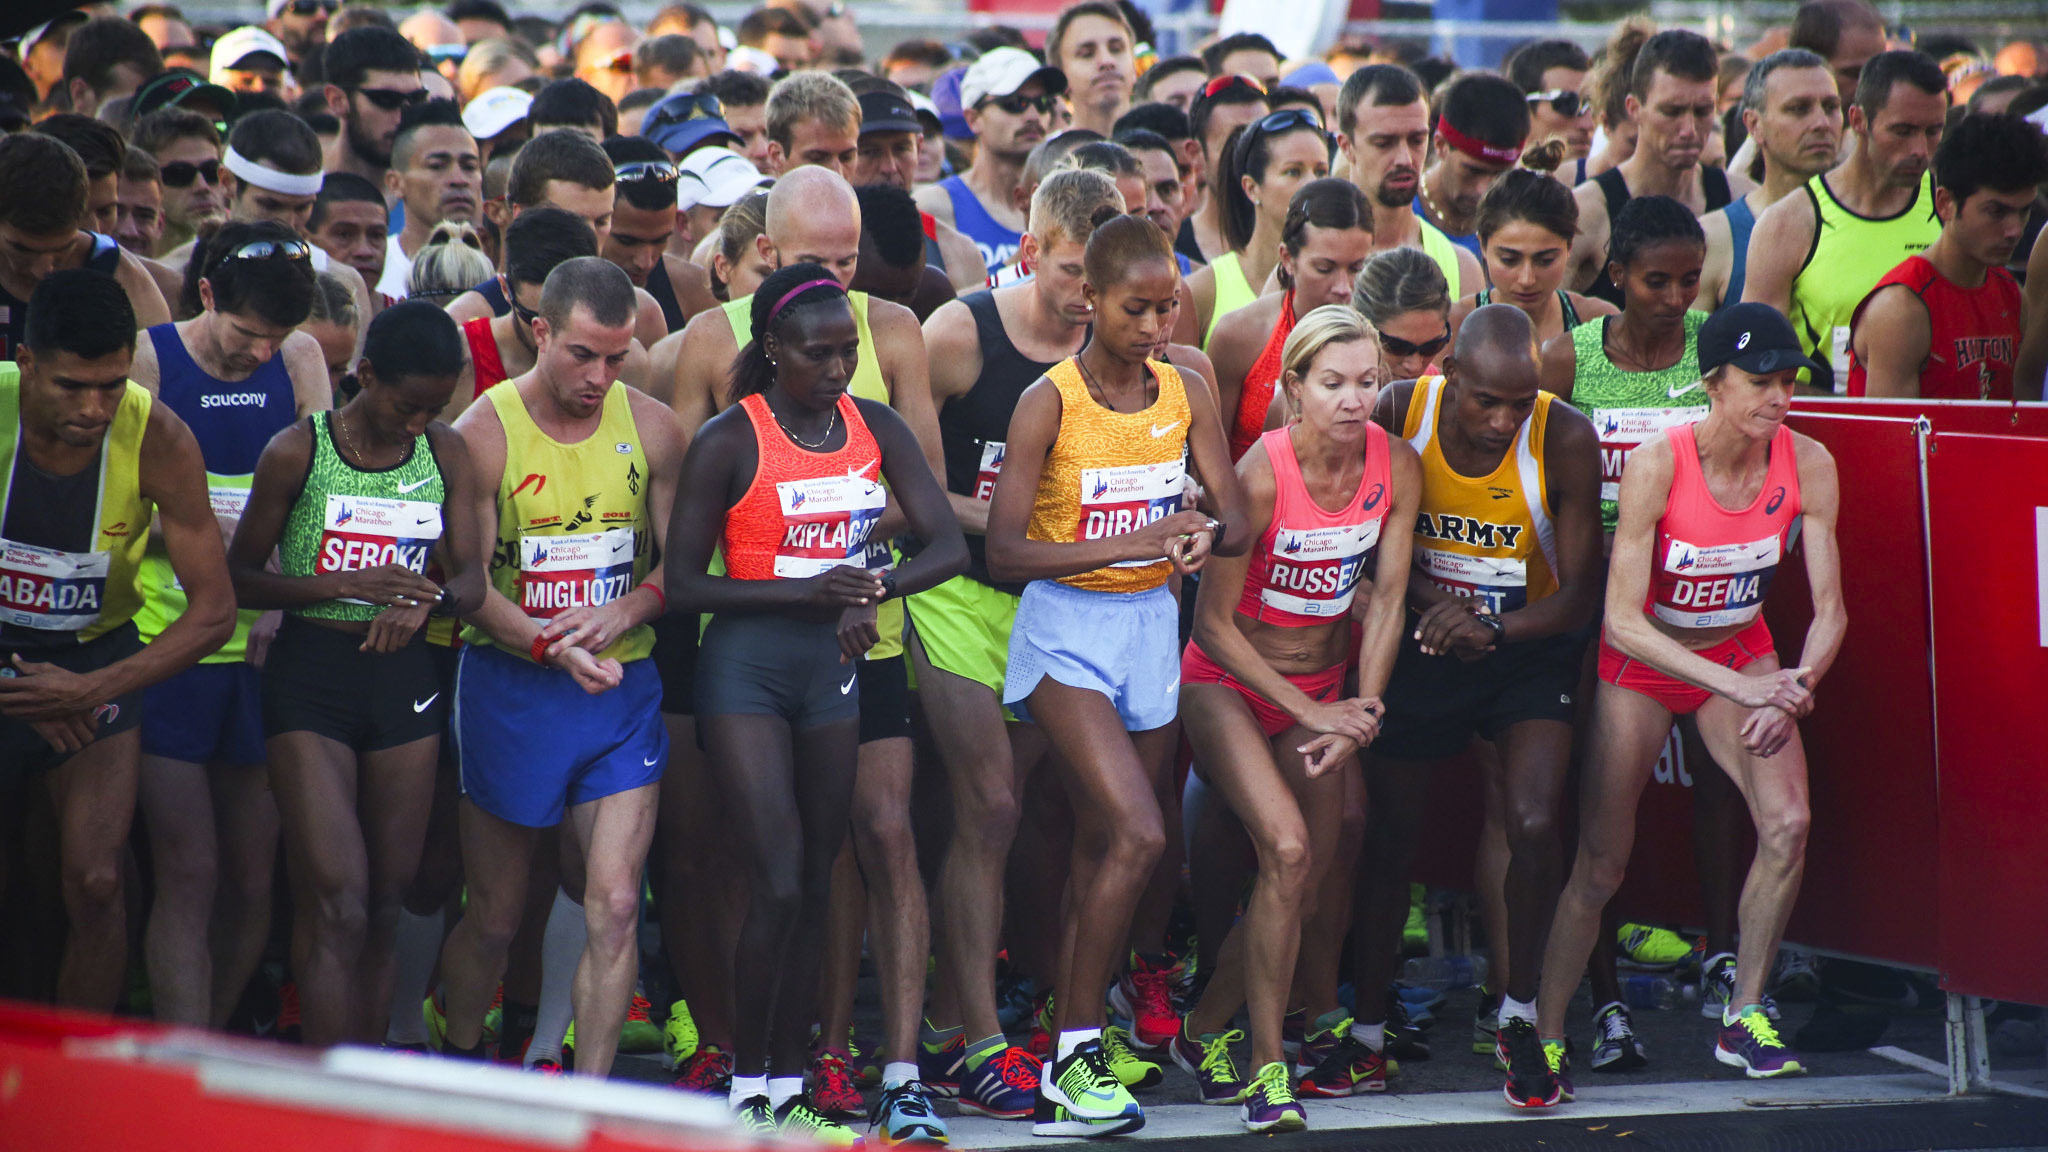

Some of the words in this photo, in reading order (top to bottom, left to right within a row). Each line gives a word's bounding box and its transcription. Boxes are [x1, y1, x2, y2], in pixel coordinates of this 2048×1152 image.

[201, 393, 266, 408] saucony
[1621, 419, 1651, 428] Chicago
[1621, 426, 1659, 434] Marathon
[1110, 478, 1138, 486] Chicago
[1110, 485, 1144, 493] Marathon
[809, 495, 843, 503] Marathon
[355, 507, 386, 519] Chicago
[355, 516, 392, 526] Marathon
[783, 517, 880, 549] KIPLAGAT
[1413, 511, 1523, 549] ARMY
[1304, 539, 1333, 547] Chicago
[550, 546, 581, 555] Chicago
[1303, 545, 1338, 553] Marathon
[321, 537, 428, 575] SEROKA
[550, 553, 589, 562] Marathon
[1433, 558, 1464, 568] Chicago
[1270, 557, 1366, 594] RUSSELL
[1433, 565, 1471, 576] Marathon
[0, 574, 98, 609] ABADA
[525, 572, 630, 609] MIGLIOZZI
[1671, 575, 1760, 608] DEENA
